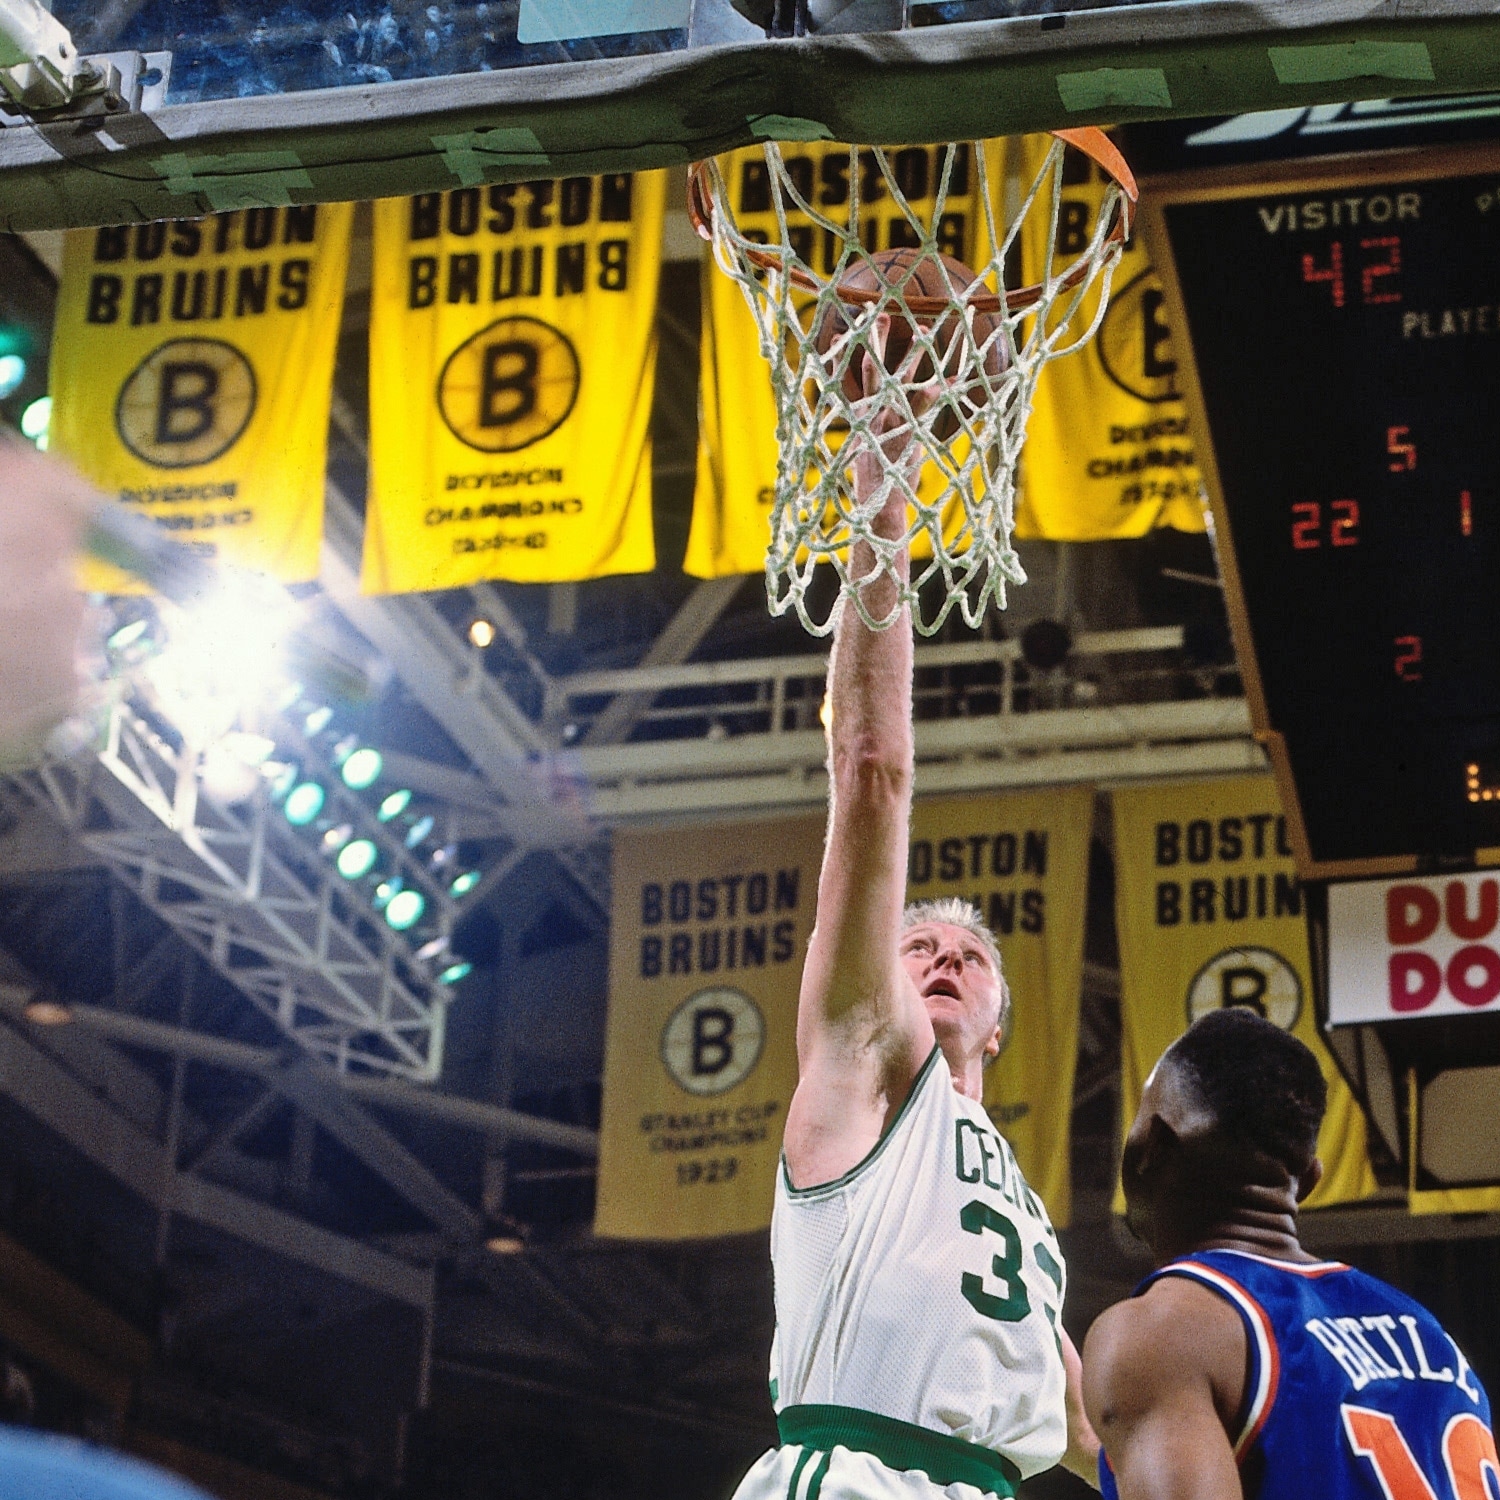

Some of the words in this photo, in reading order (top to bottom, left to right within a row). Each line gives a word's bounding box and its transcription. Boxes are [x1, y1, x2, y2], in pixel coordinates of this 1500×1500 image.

[94, 205, 316, 262] BOSTON
[410, 173, 632, 240] BOSTON
[1259, 192, 1421, 233] VISITOR
[87, 258, 309, 326] BRUINS
[408, 240, 627, 309] BRUINS
[1303, 237, 1402, 307] 42
[155, 361, 218, 443] B
[478, 341, 541, 427] B
[1387, 425, 1416, 472] 5
[1292, 500, 1360, 549] 22
[1461, 490, 1471, 536] 1
[1395, 635, 1422, 681] 2
[911, 831, 1048, 885] OSTON
[641, 869, 800, 926] BOSTON
[641, 920, 796, 978] BRUINS
[692, 1007, 735, 1076] B
